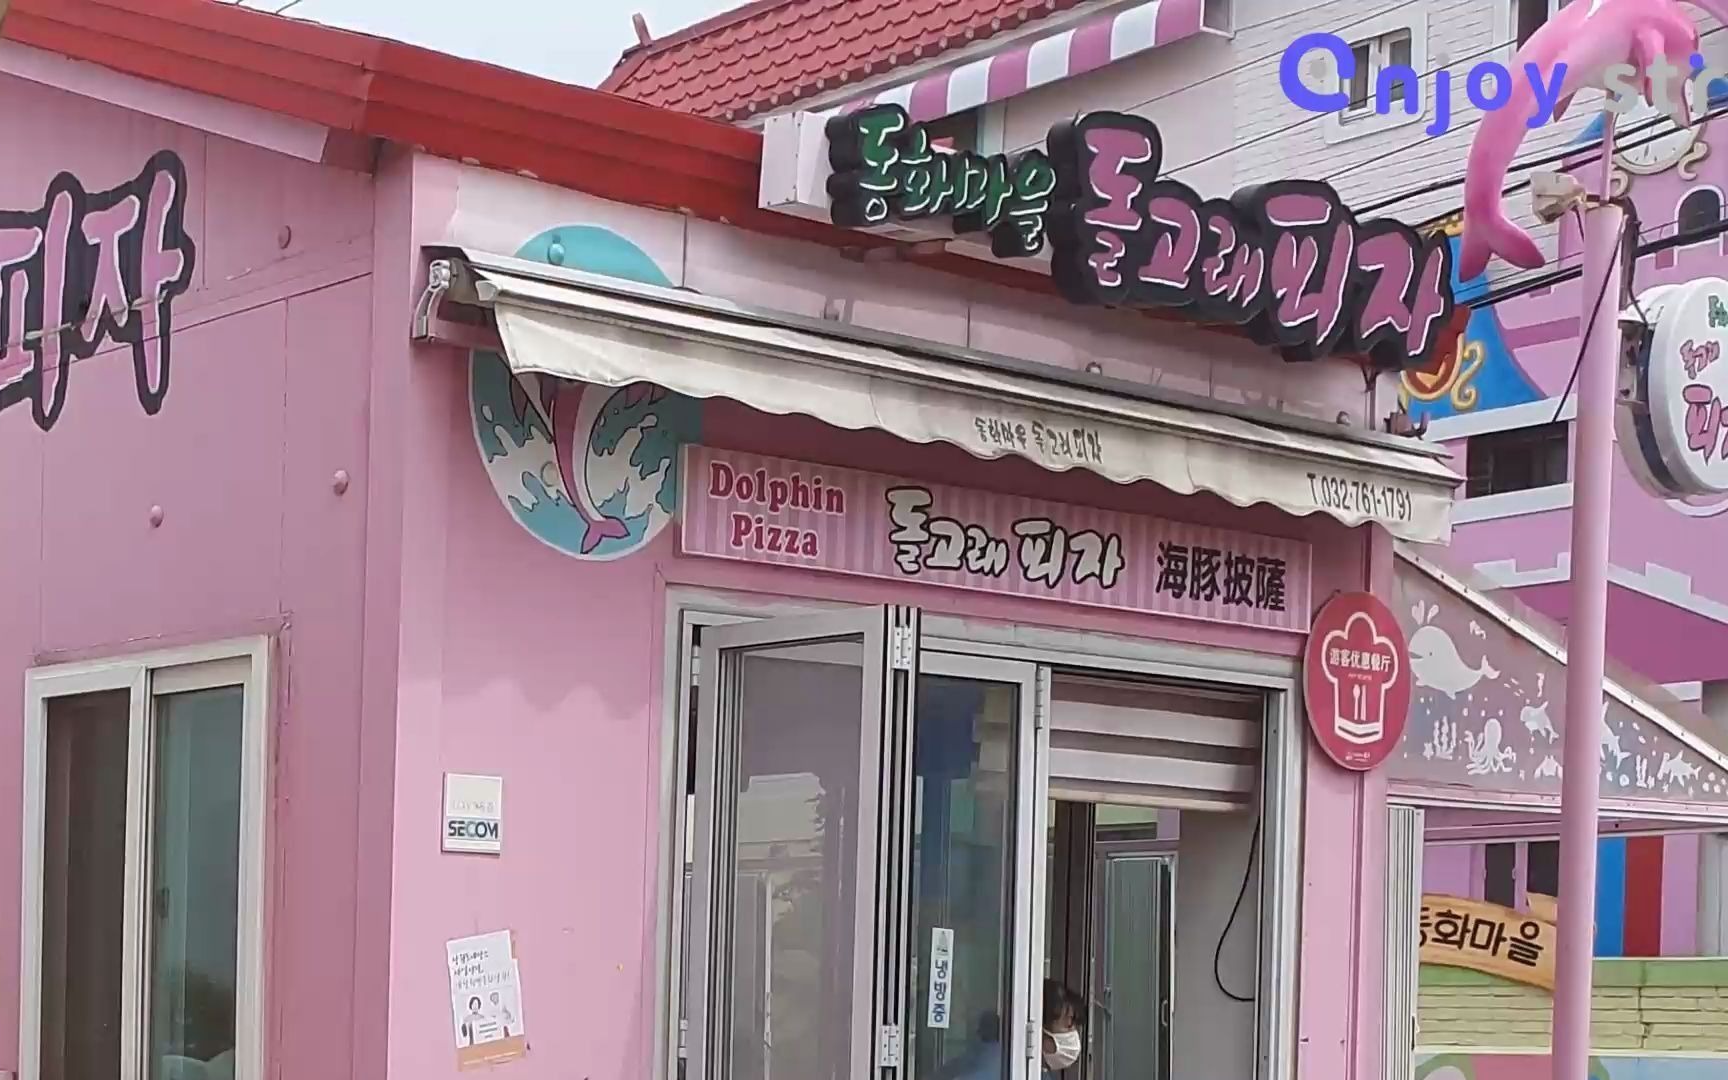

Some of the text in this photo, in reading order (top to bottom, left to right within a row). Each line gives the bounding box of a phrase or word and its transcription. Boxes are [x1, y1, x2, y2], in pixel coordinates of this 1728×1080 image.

[858, 110, 1449, 360] 동화마을 돌고래피자
[709, 461, 845, 515] Dolphin
[731, 513, 819, 558] Pizza
[885, 485, 1125, 589] 돌고래 피자
